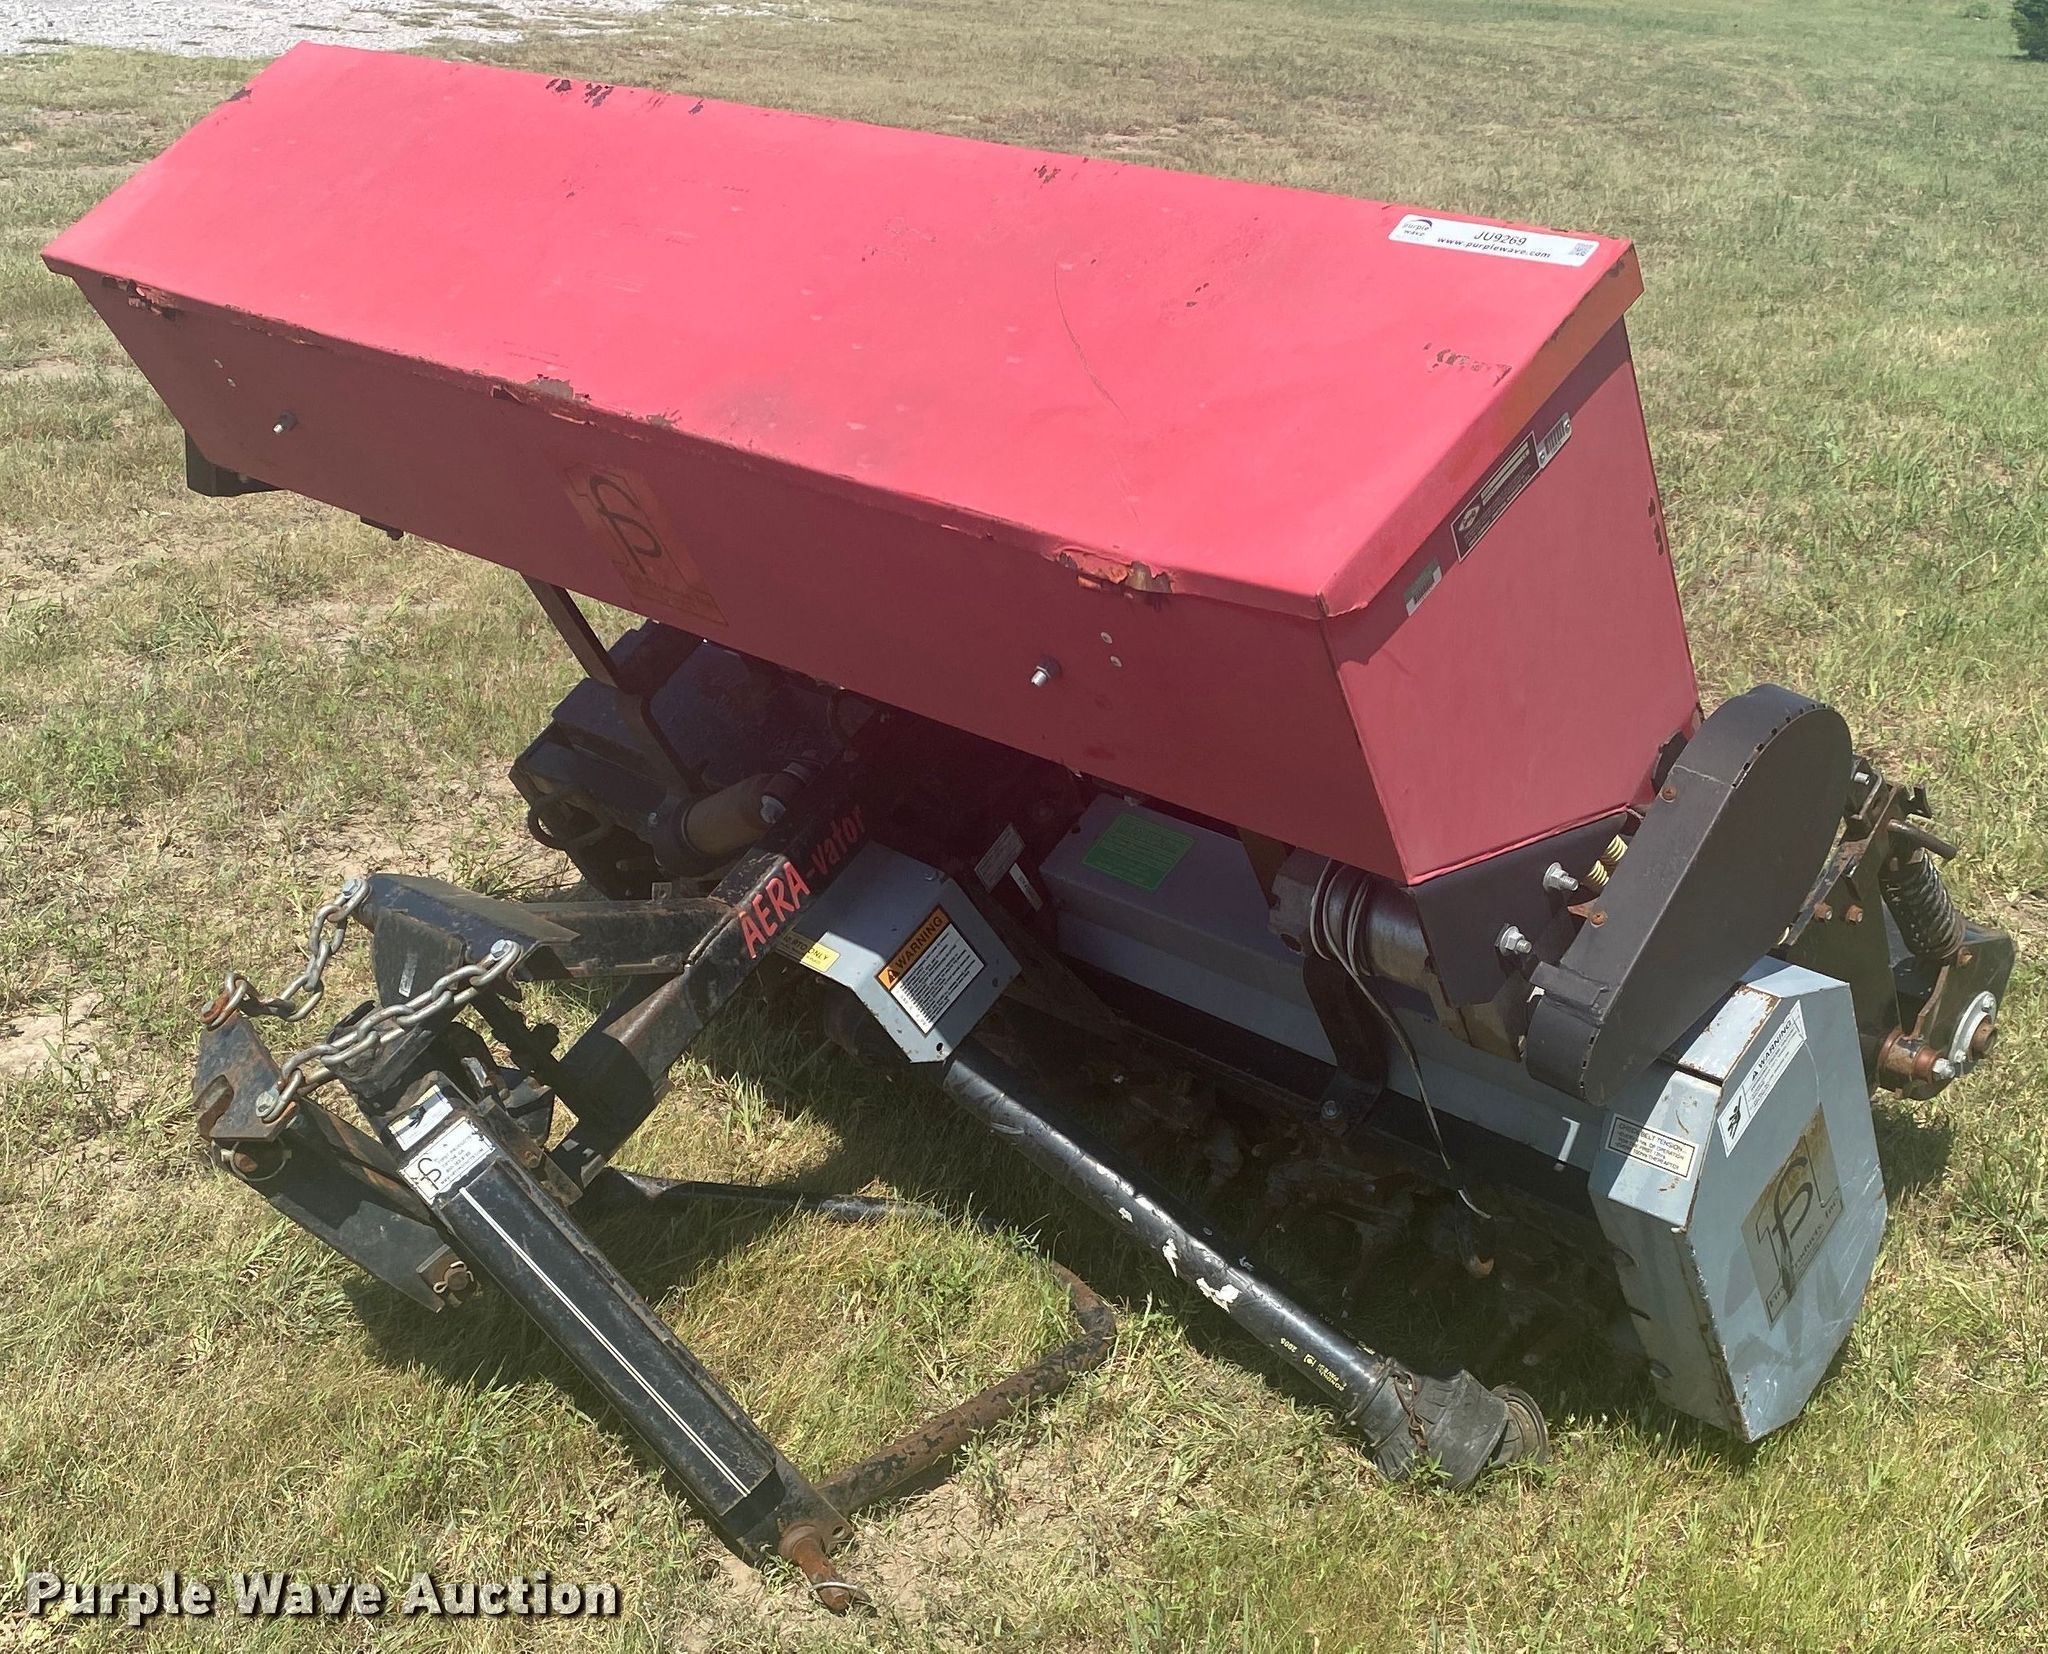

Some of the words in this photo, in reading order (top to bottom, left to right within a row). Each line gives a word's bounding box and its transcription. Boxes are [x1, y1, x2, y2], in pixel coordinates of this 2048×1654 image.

[1437, 237, 1551, 258] www.purplewave.com
[1473, 231, 1527, 246] JU9269
[894, 914, 943, 969] WARNING
[807, 946, 829, 961] ONLY
[1756, 1018, 1792, 1069] WARNING
